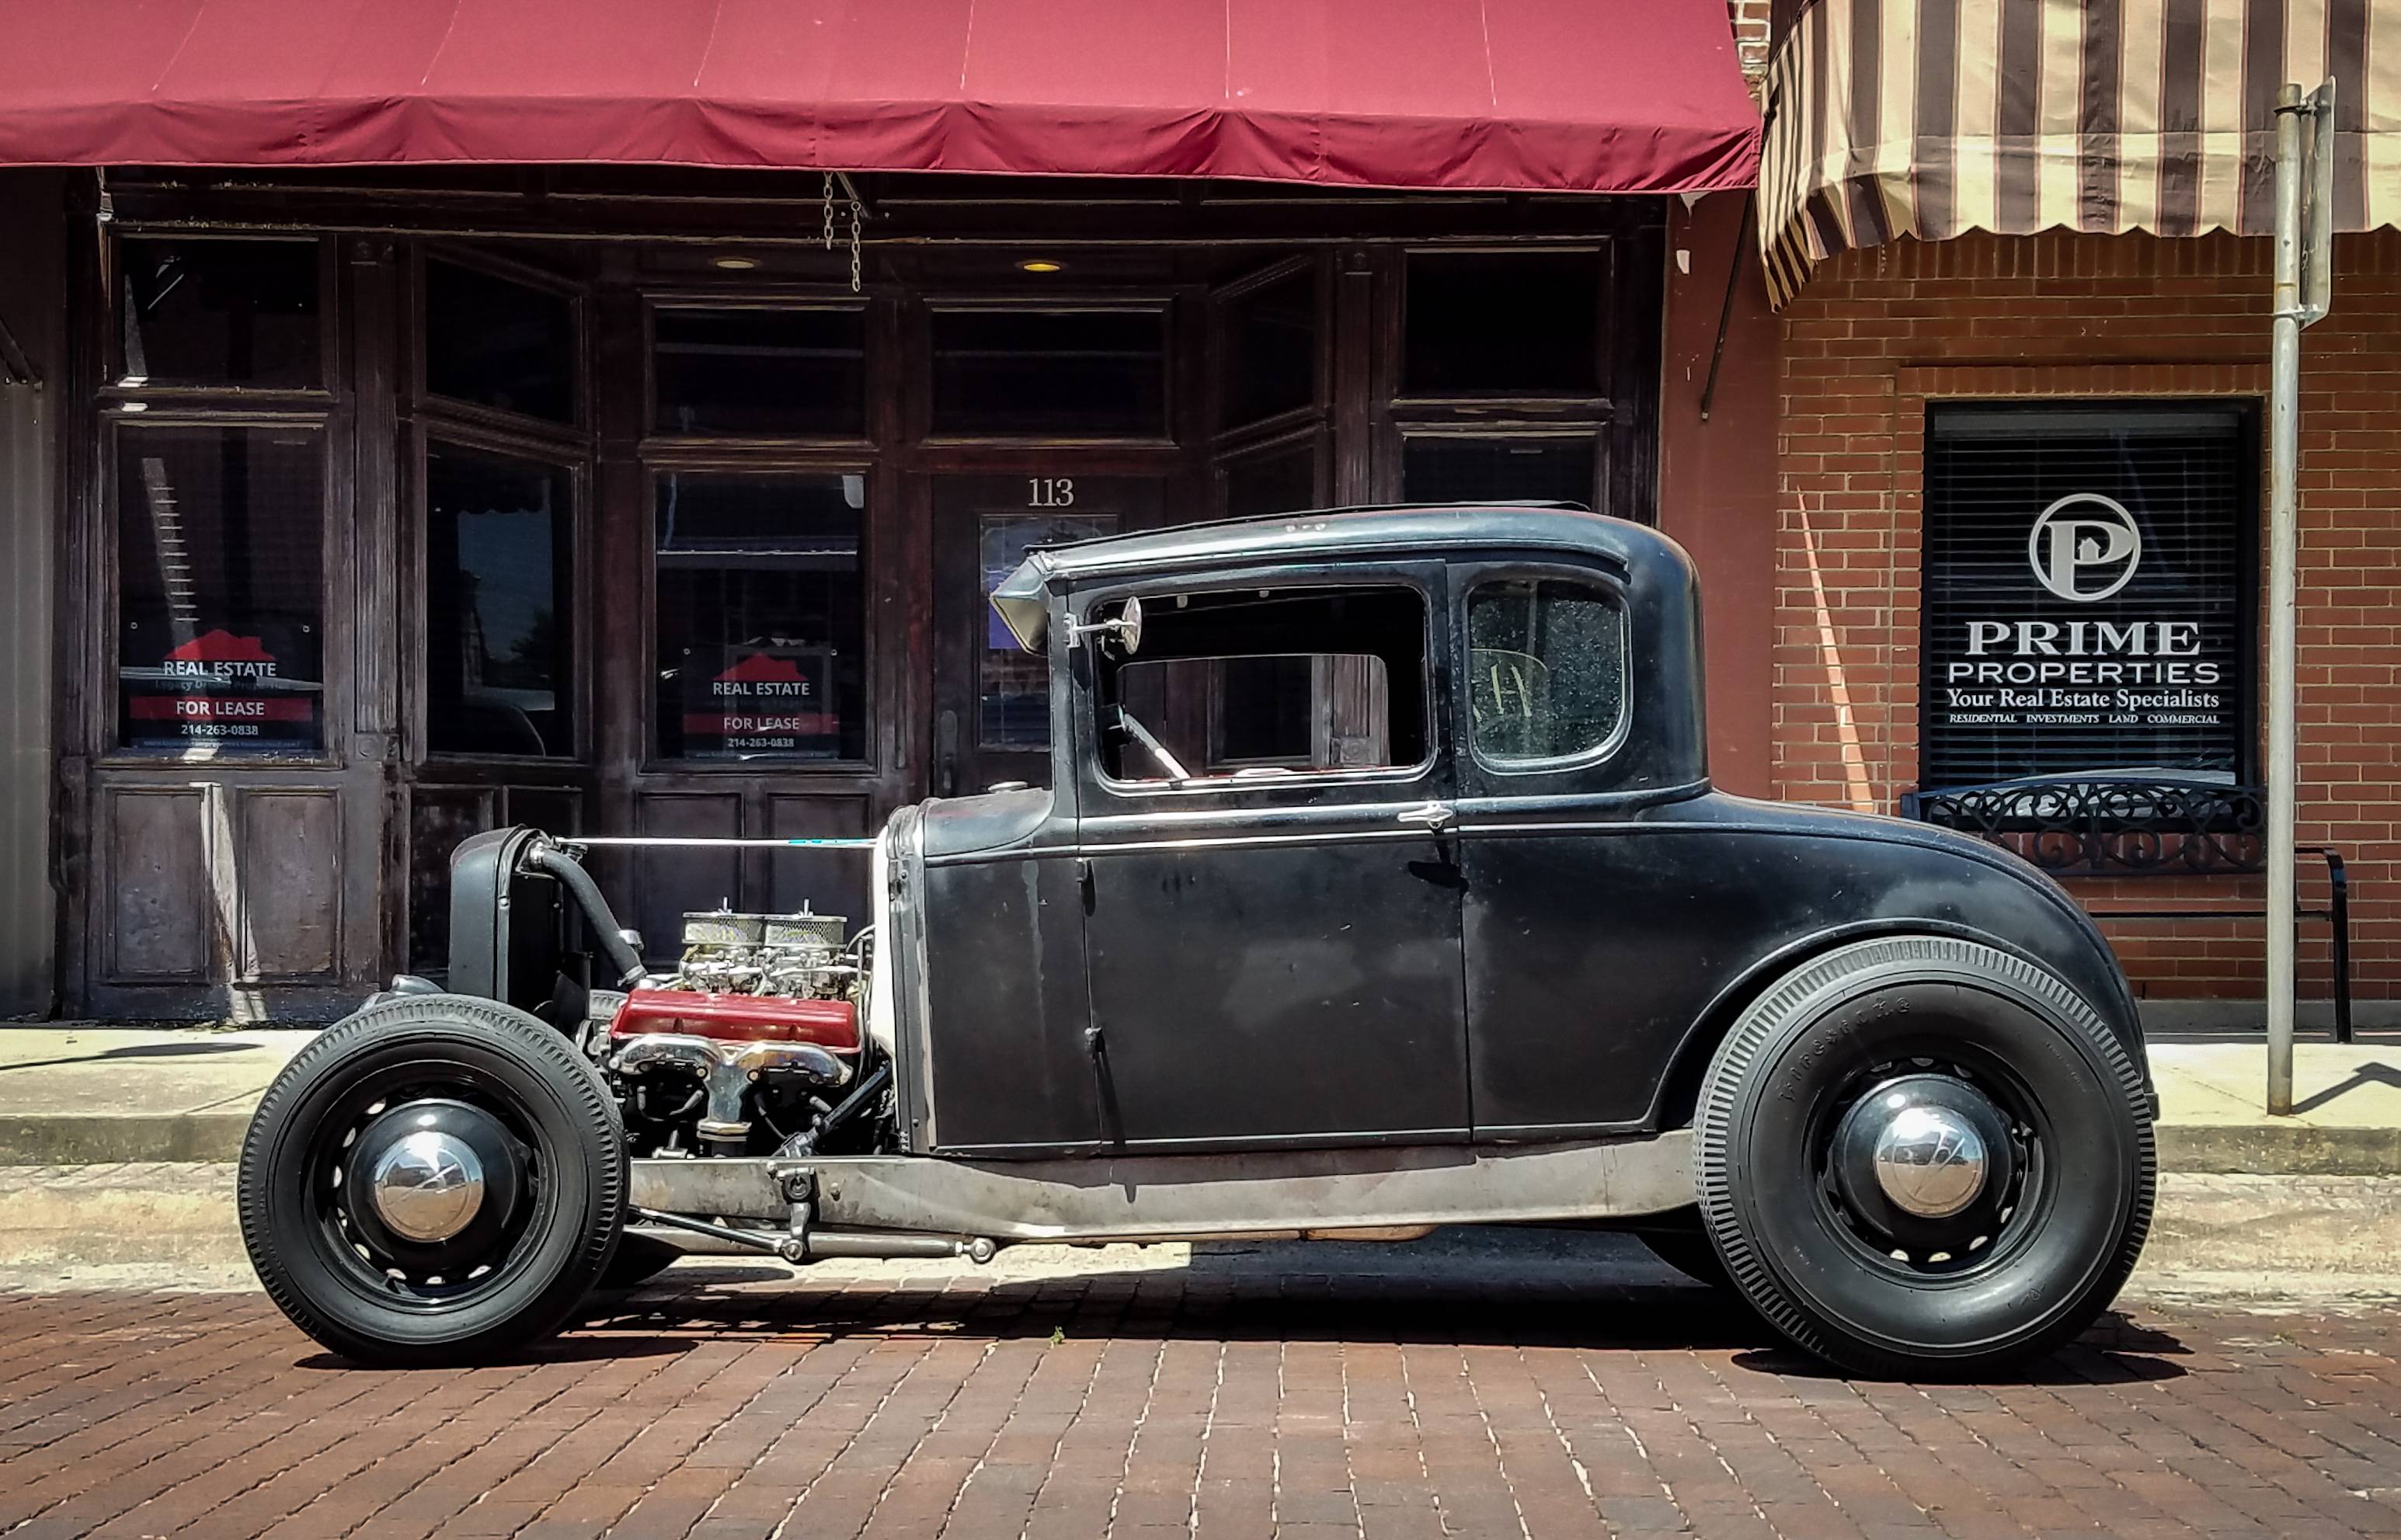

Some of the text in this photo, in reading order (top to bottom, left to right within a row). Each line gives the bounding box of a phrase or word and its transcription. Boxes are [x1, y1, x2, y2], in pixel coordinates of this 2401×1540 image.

[1028, 477, 1074, 507] 113
[1964, 621, 2201, 655] PRIME
[163, 661, 277, 677] REAL ESTATE
[1948, 662, 2220, 683] PROPERTIES
[712, 682, 810, 696] REAL ESTATE
[1947, 688, 2219, 711] Your Real Estate Specialists
[176, 700, 266, 716] FOR LEASE
[723, 718, 800, 730] FOR LEASE
[1950, 714, 2220, 725] RESIDENTIAL INVESTMENTS LAND COMMERCIAL
[181, 724, 259, 735] 214-263-0838
[728, 738, 795, 748] 214-263-0838
